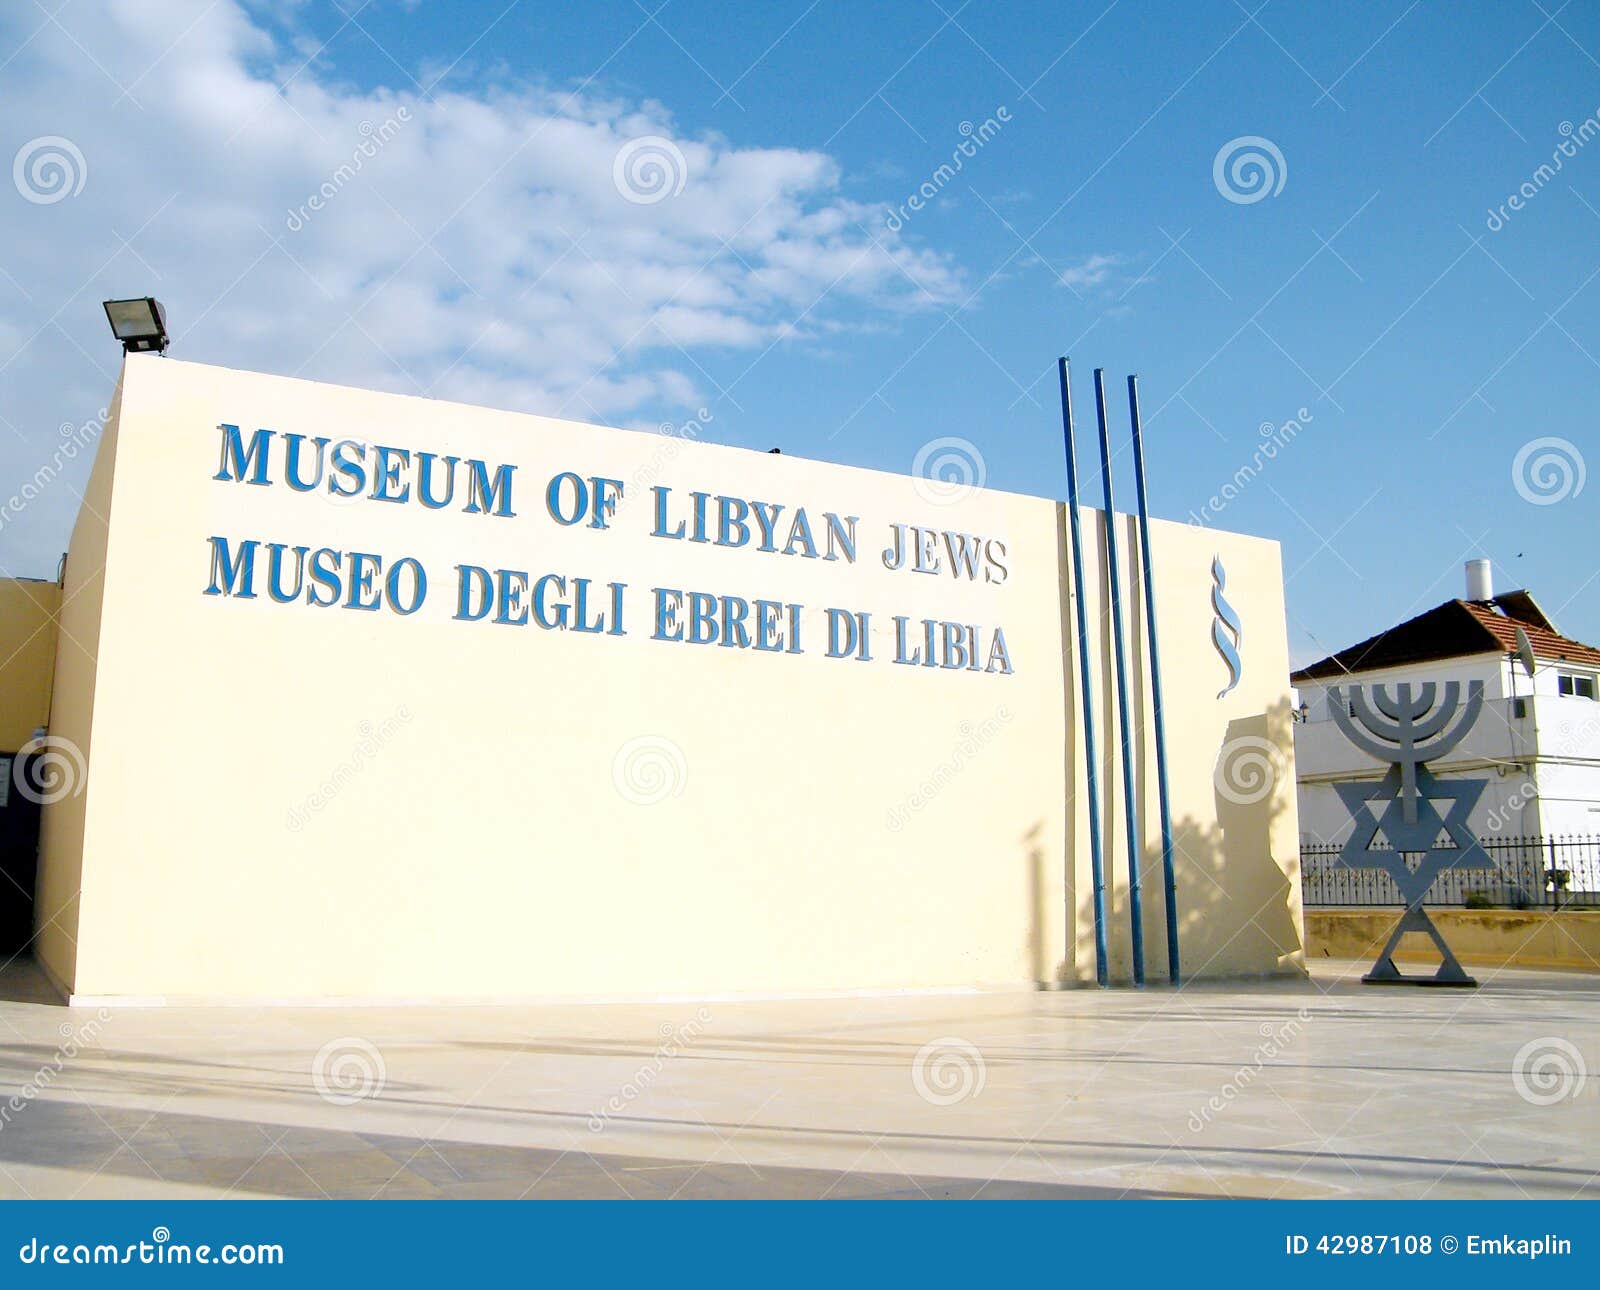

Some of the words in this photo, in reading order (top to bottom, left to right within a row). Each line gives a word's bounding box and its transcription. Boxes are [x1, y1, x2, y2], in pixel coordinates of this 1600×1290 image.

[212, 423, 518, 518] MUSEUM
[546, 472, 625, 529] OF
[650, 486, 859, 564] LIBYAN
[882, 522, 1008, 585] JEWS
[203, 536, 427, 615] MUSEO
[452, 564, 628, 636] DEGLI
[650, 587, 805, 654] EBREI
[824, 607, 873, 661] DI
[892, 615, 1014, 676] LIBIA
